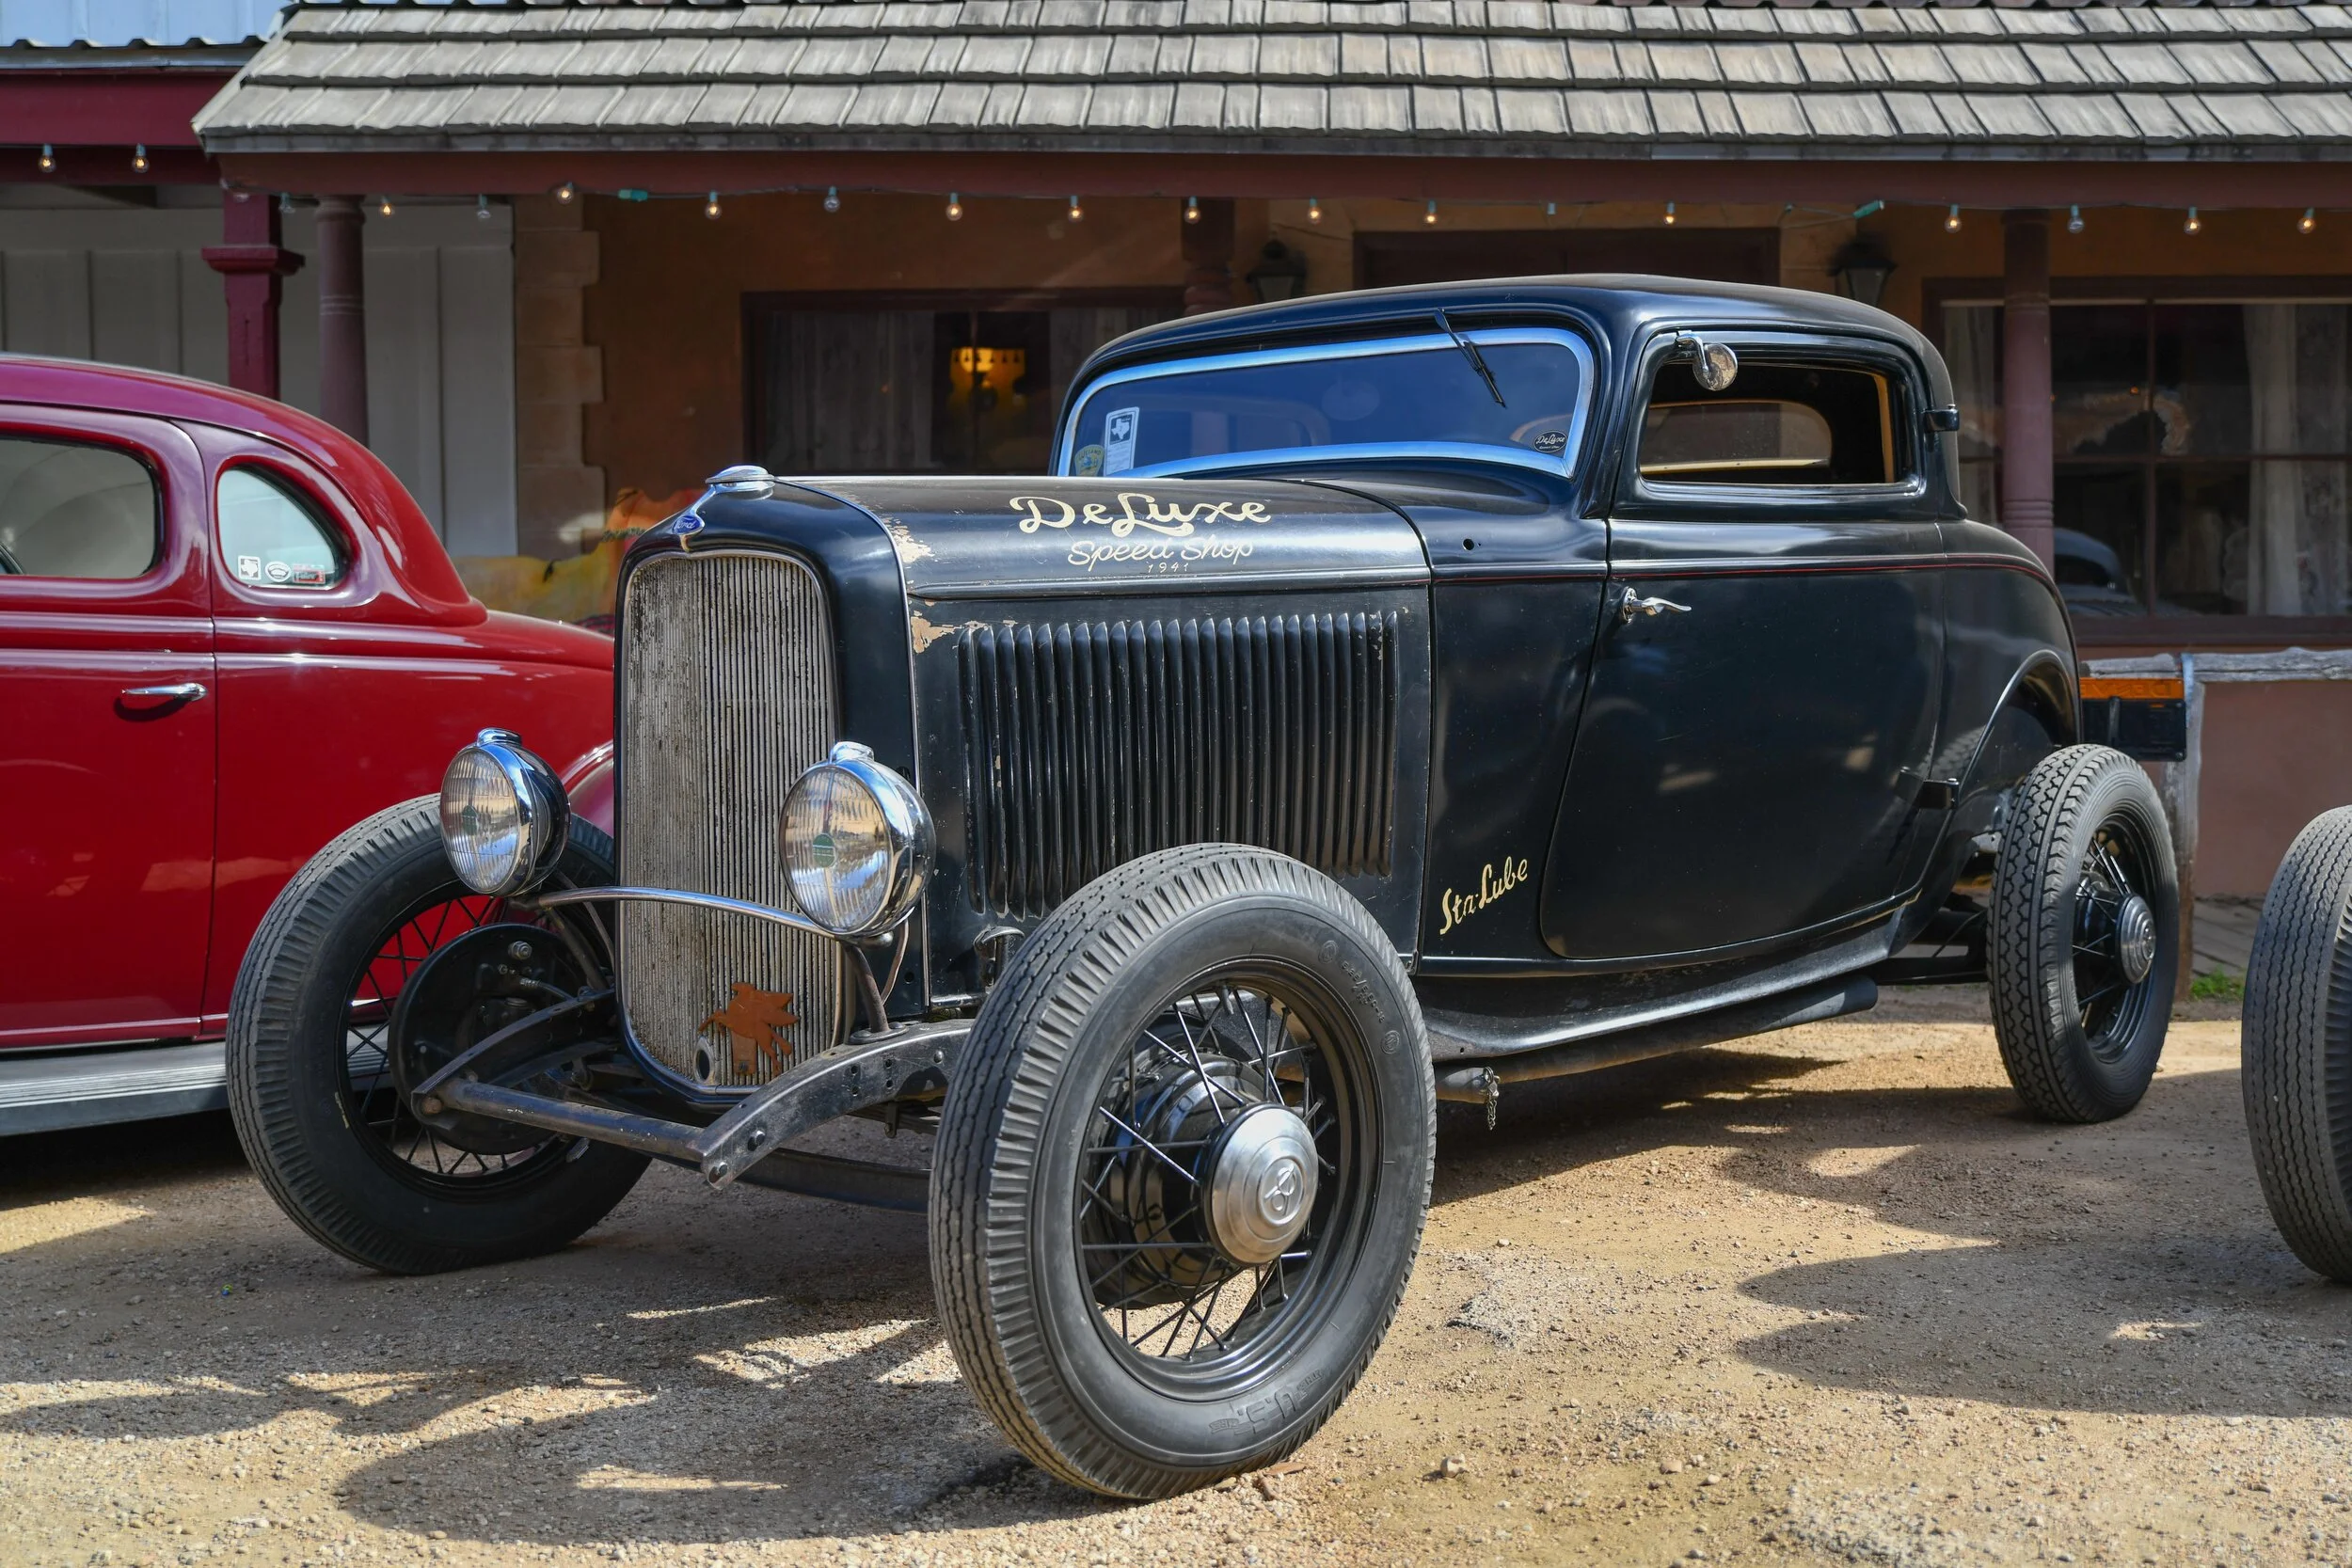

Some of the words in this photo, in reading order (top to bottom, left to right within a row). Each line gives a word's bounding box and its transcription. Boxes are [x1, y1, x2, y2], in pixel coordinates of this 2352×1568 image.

[674, 519, 697, 530] Ford
[1068, 537, 1175, 572] Speed
[1181, 534, 1253, 564] Shop
[1147, 562, 1189, 574] 1941
